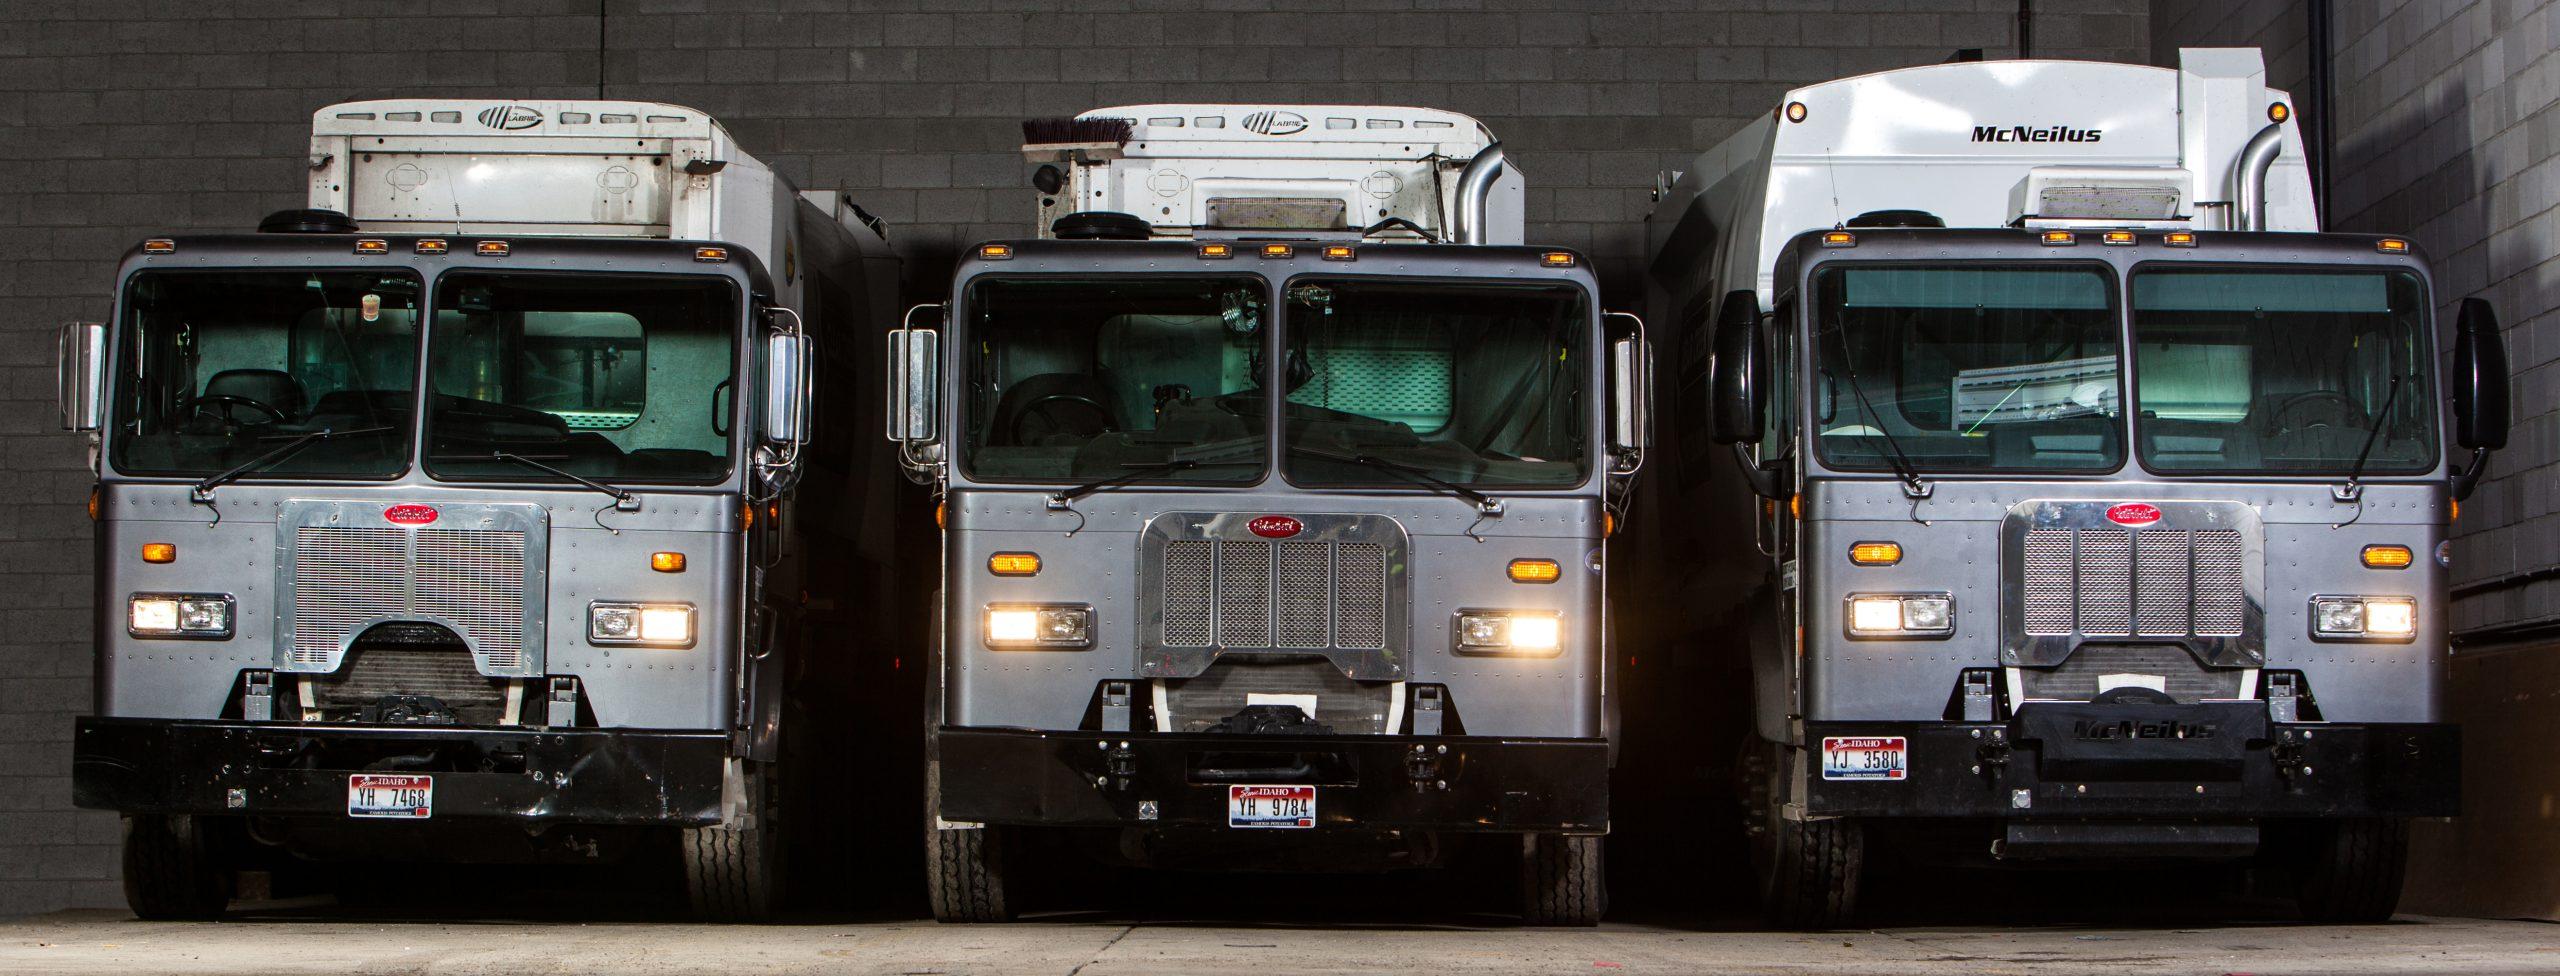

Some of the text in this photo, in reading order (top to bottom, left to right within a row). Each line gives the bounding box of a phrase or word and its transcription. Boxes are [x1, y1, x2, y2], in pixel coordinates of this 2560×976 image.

[1971, 126, 2102, 142] McNeilus
[2073, 720, 2216, 740] McNeilus
[1832, 750, 1898, 769] YJ 3580
[378, 778, 407, 786] IDAHO
[359, 788, 425, 807] YH 7468
[1259, 788, 1289, 796] IDAHO
[1240, 798, 1308, 816] YH 9784
